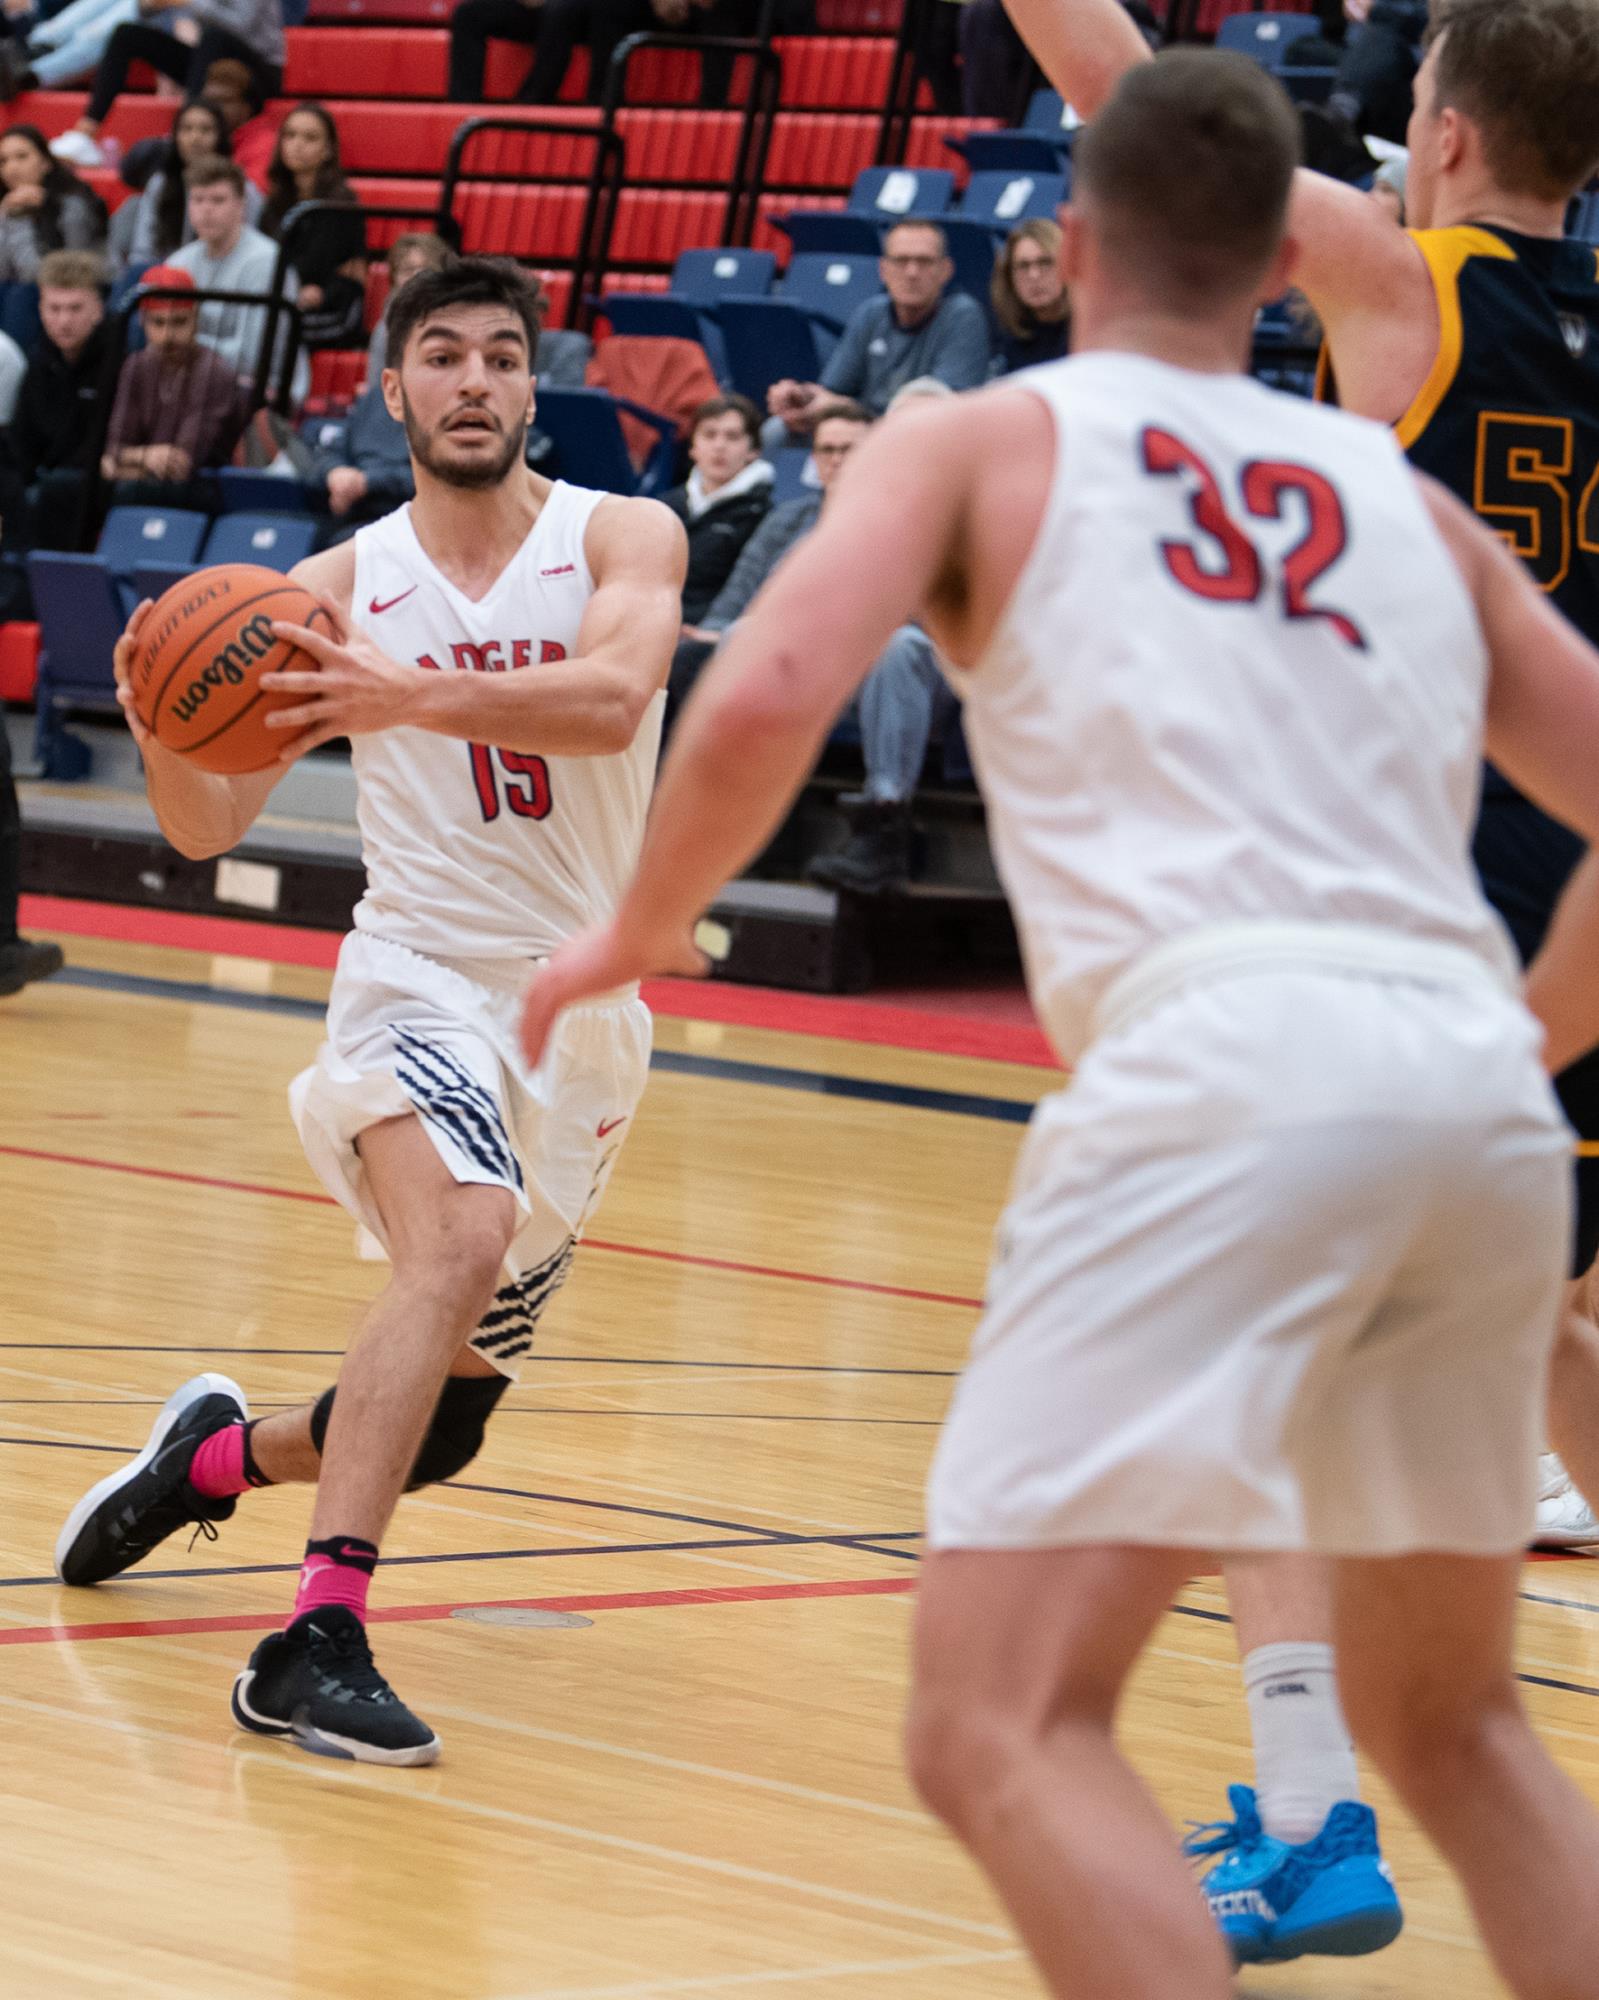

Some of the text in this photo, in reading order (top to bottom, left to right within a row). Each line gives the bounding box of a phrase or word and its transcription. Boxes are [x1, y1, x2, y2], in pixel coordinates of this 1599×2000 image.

[1136, 424, 1369, 651] 32
[1473, 410, 1599, 593] 5
[171, 613, 278, 722] Wilson
[467, 740, 554, 823] 15
